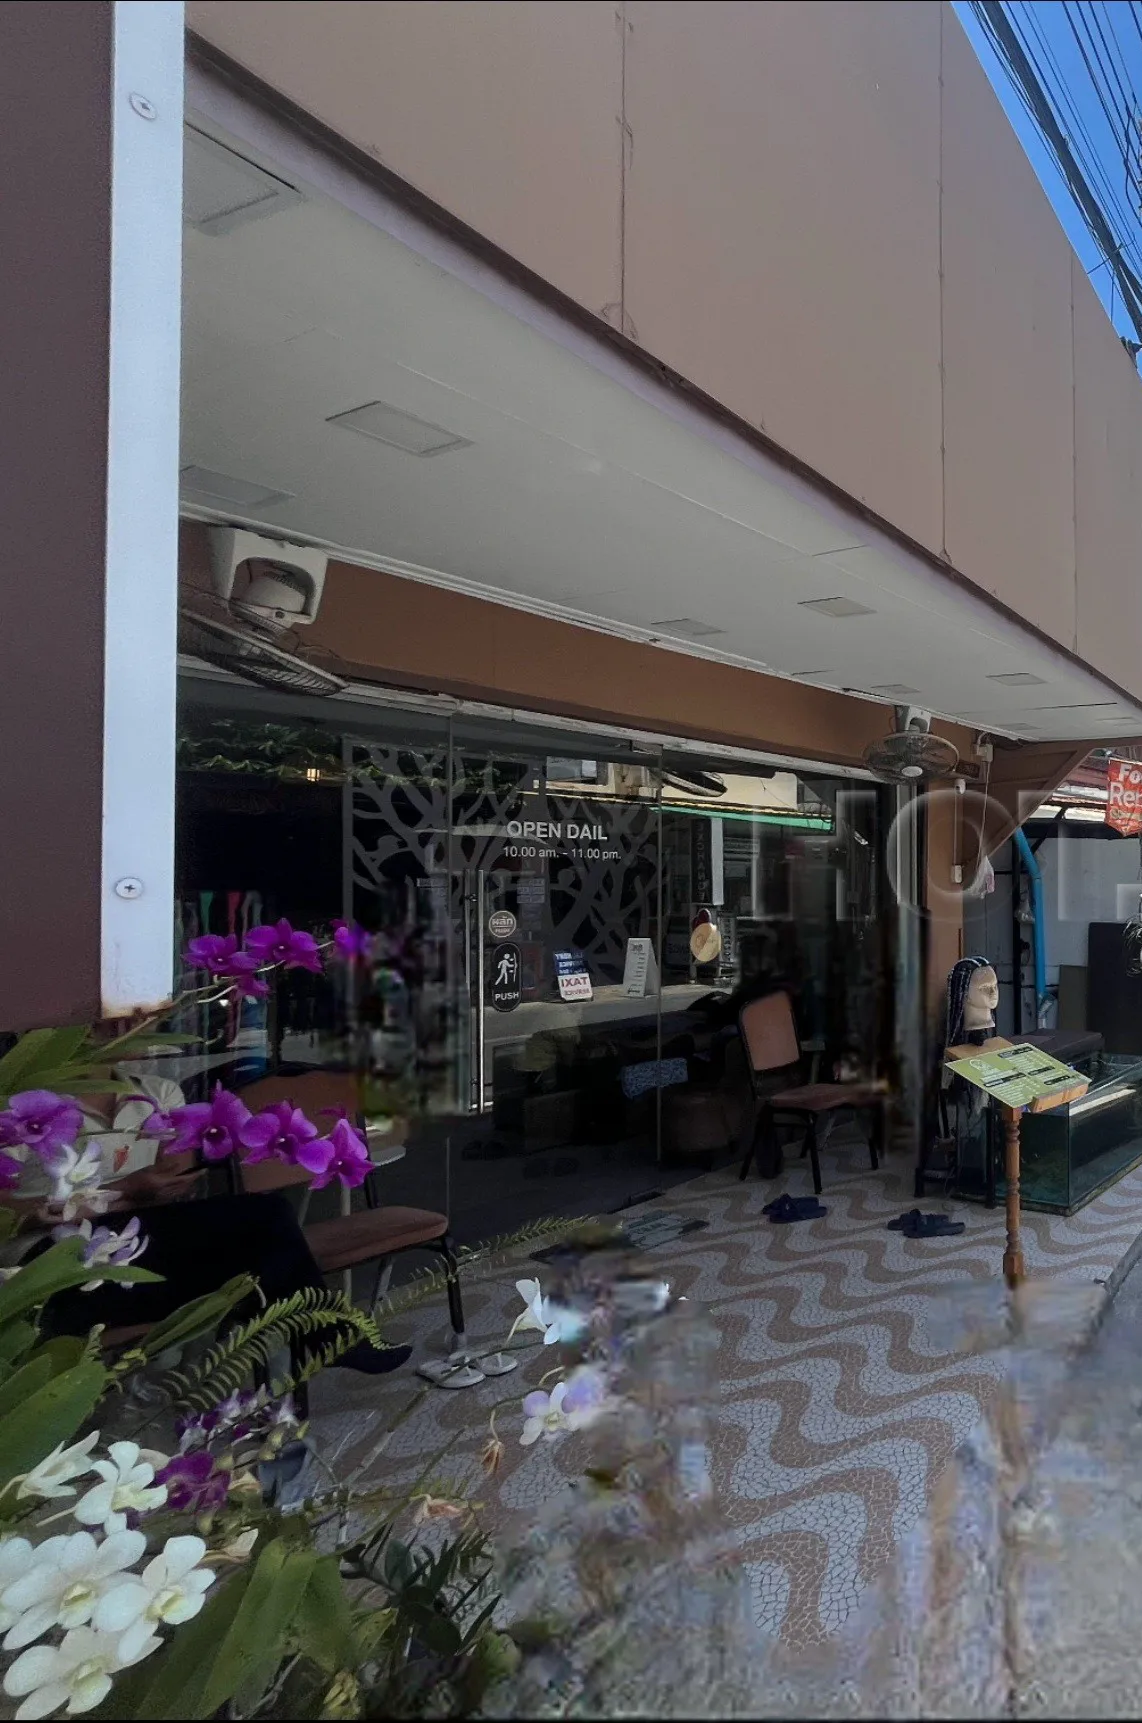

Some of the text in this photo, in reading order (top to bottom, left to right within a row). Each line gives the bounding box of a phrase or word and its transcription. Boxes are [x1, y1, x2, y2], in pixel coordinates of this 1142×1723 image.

[506, 820, 608, 841] OPEN DAIL
[503, 846, 536, 858] 10.00
[571, 848, 599, 859] 11.00
[602, 850, 622, 861] pm.
[494, 992, 520, 1002] PUSH
